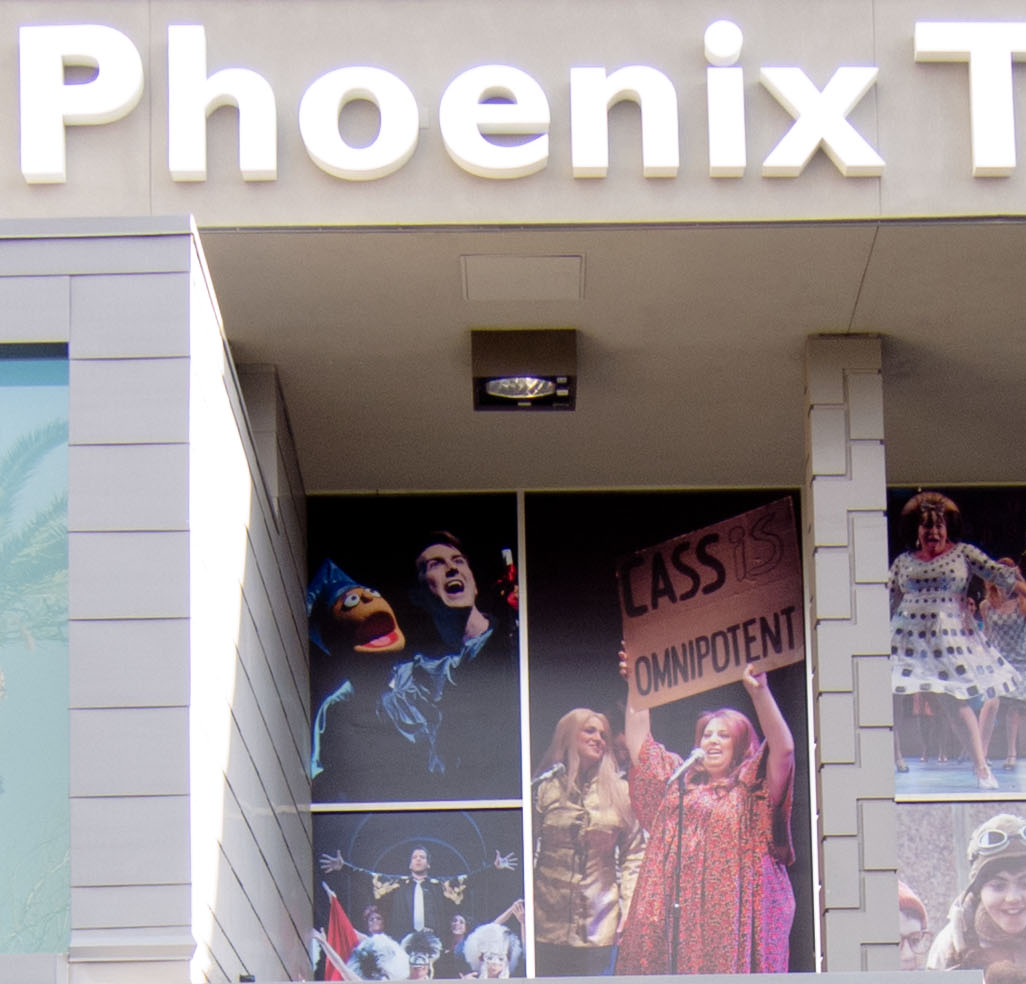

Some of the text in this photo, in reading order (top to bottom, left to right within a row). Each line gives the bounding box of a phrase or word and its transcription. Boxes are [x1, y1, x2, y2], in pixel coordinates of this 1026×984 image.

[18, 20, 886, 184] Phoenix
[621, 533, 726, 618] CASS
[634, 605, 796, 697] OMNIPOTENT
